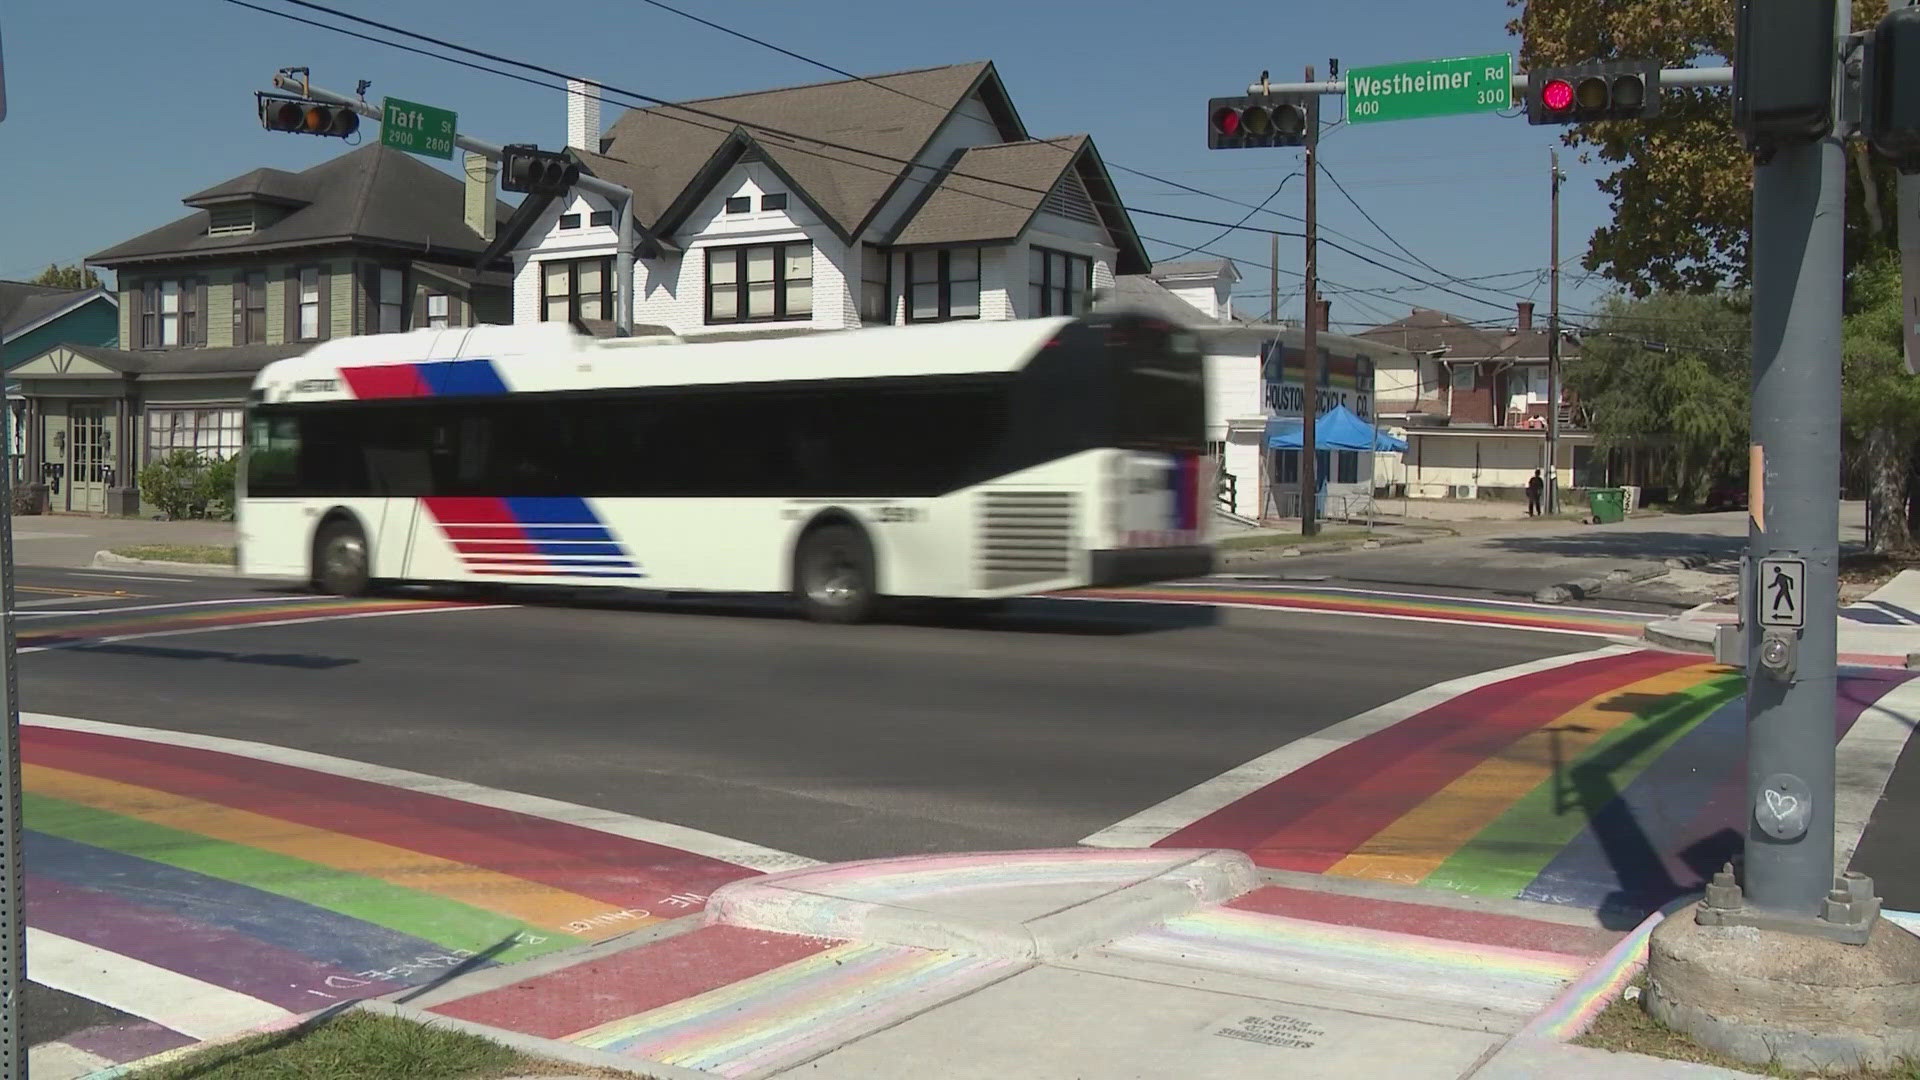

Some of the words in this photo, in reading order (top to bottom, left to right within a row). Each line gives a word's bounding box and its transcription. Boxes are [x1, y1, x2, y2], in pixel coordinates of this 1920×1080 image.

[1354, 70, 1473, 98] Westheimer
[1484, 66, 1504, 81] Rd
[1477, 88, 1505, 105] 300
[1354, 101, 1379, 116] 400
[389, 105, 425, 131] Taft
[441, 120, 452, 134] St
[388, 129, 413, 146] 2900
[425, 137, 450, 152] 2800
[1356, 394, 1369, 417] CO.
